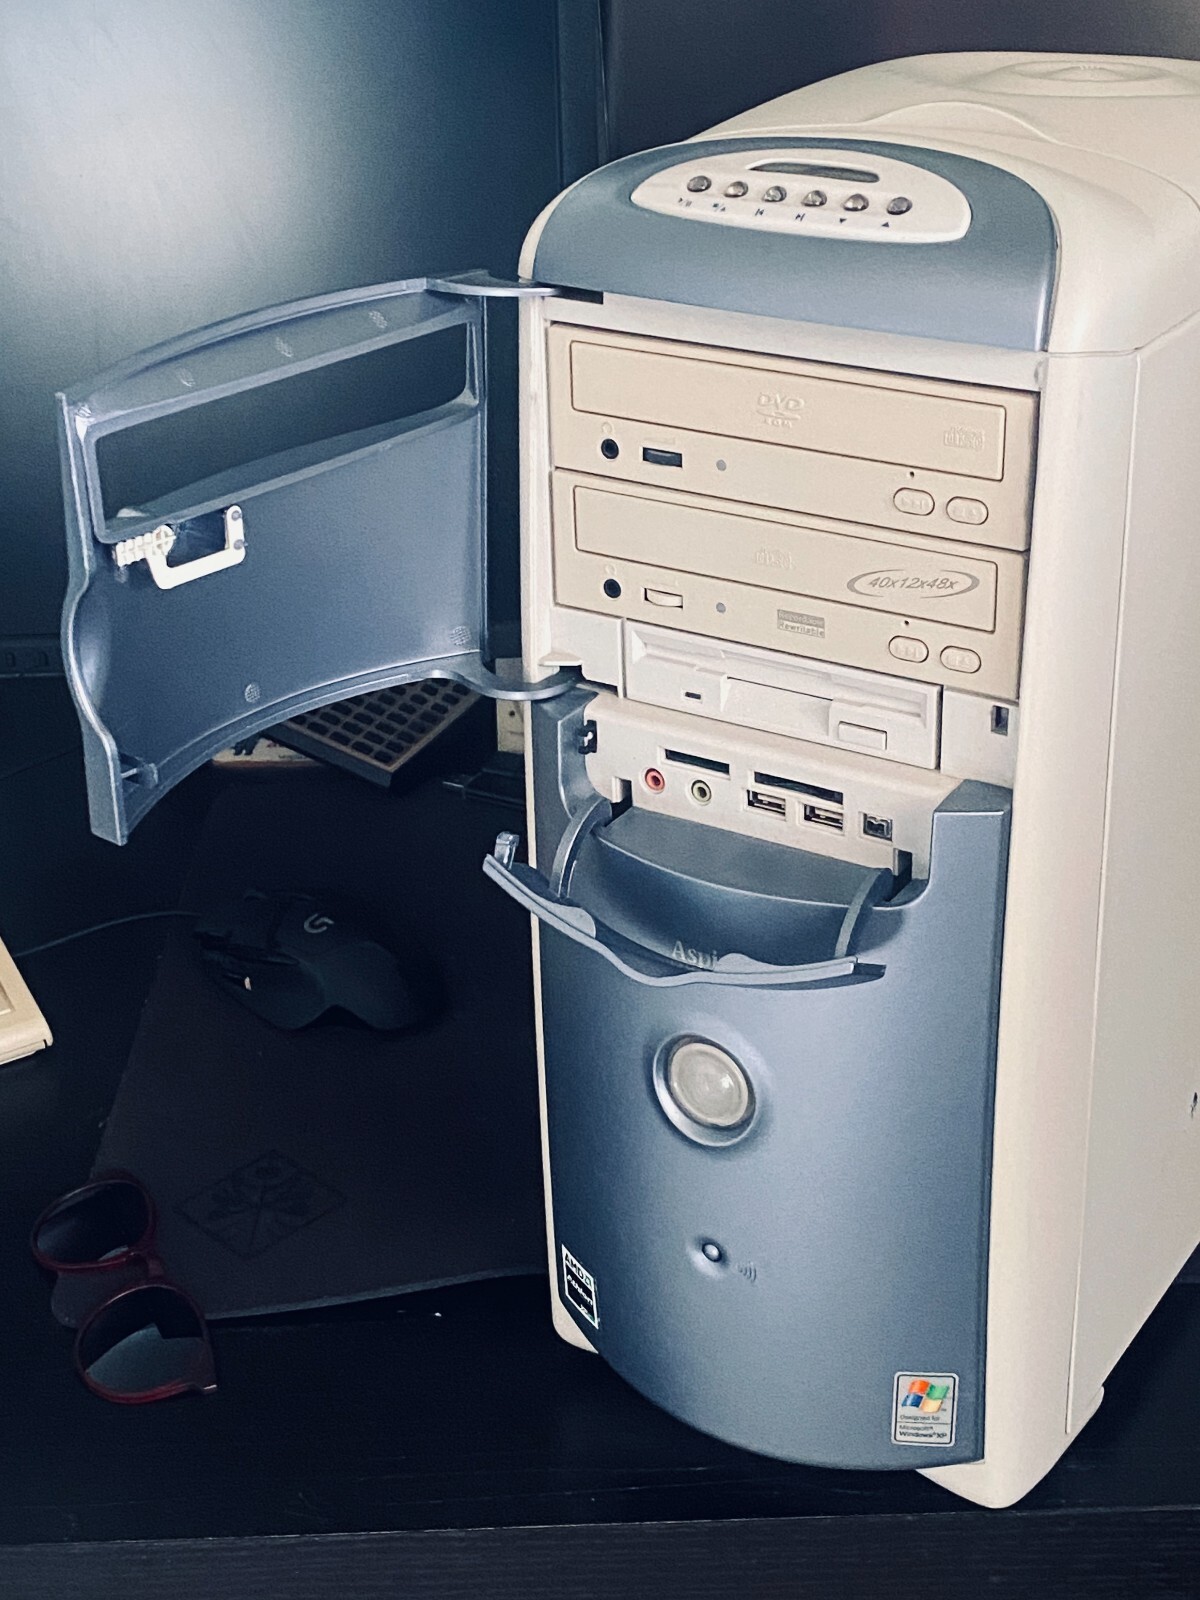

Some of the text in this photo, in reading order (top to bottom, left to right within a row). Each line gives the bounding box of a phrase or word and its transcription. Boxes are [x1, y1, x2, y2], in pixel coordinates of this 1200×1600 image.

[757, 393, 805, 411] DVD
[868, 577, 960, 590] 40x12x48x
[564, 1252, 584, 1280] AMD
